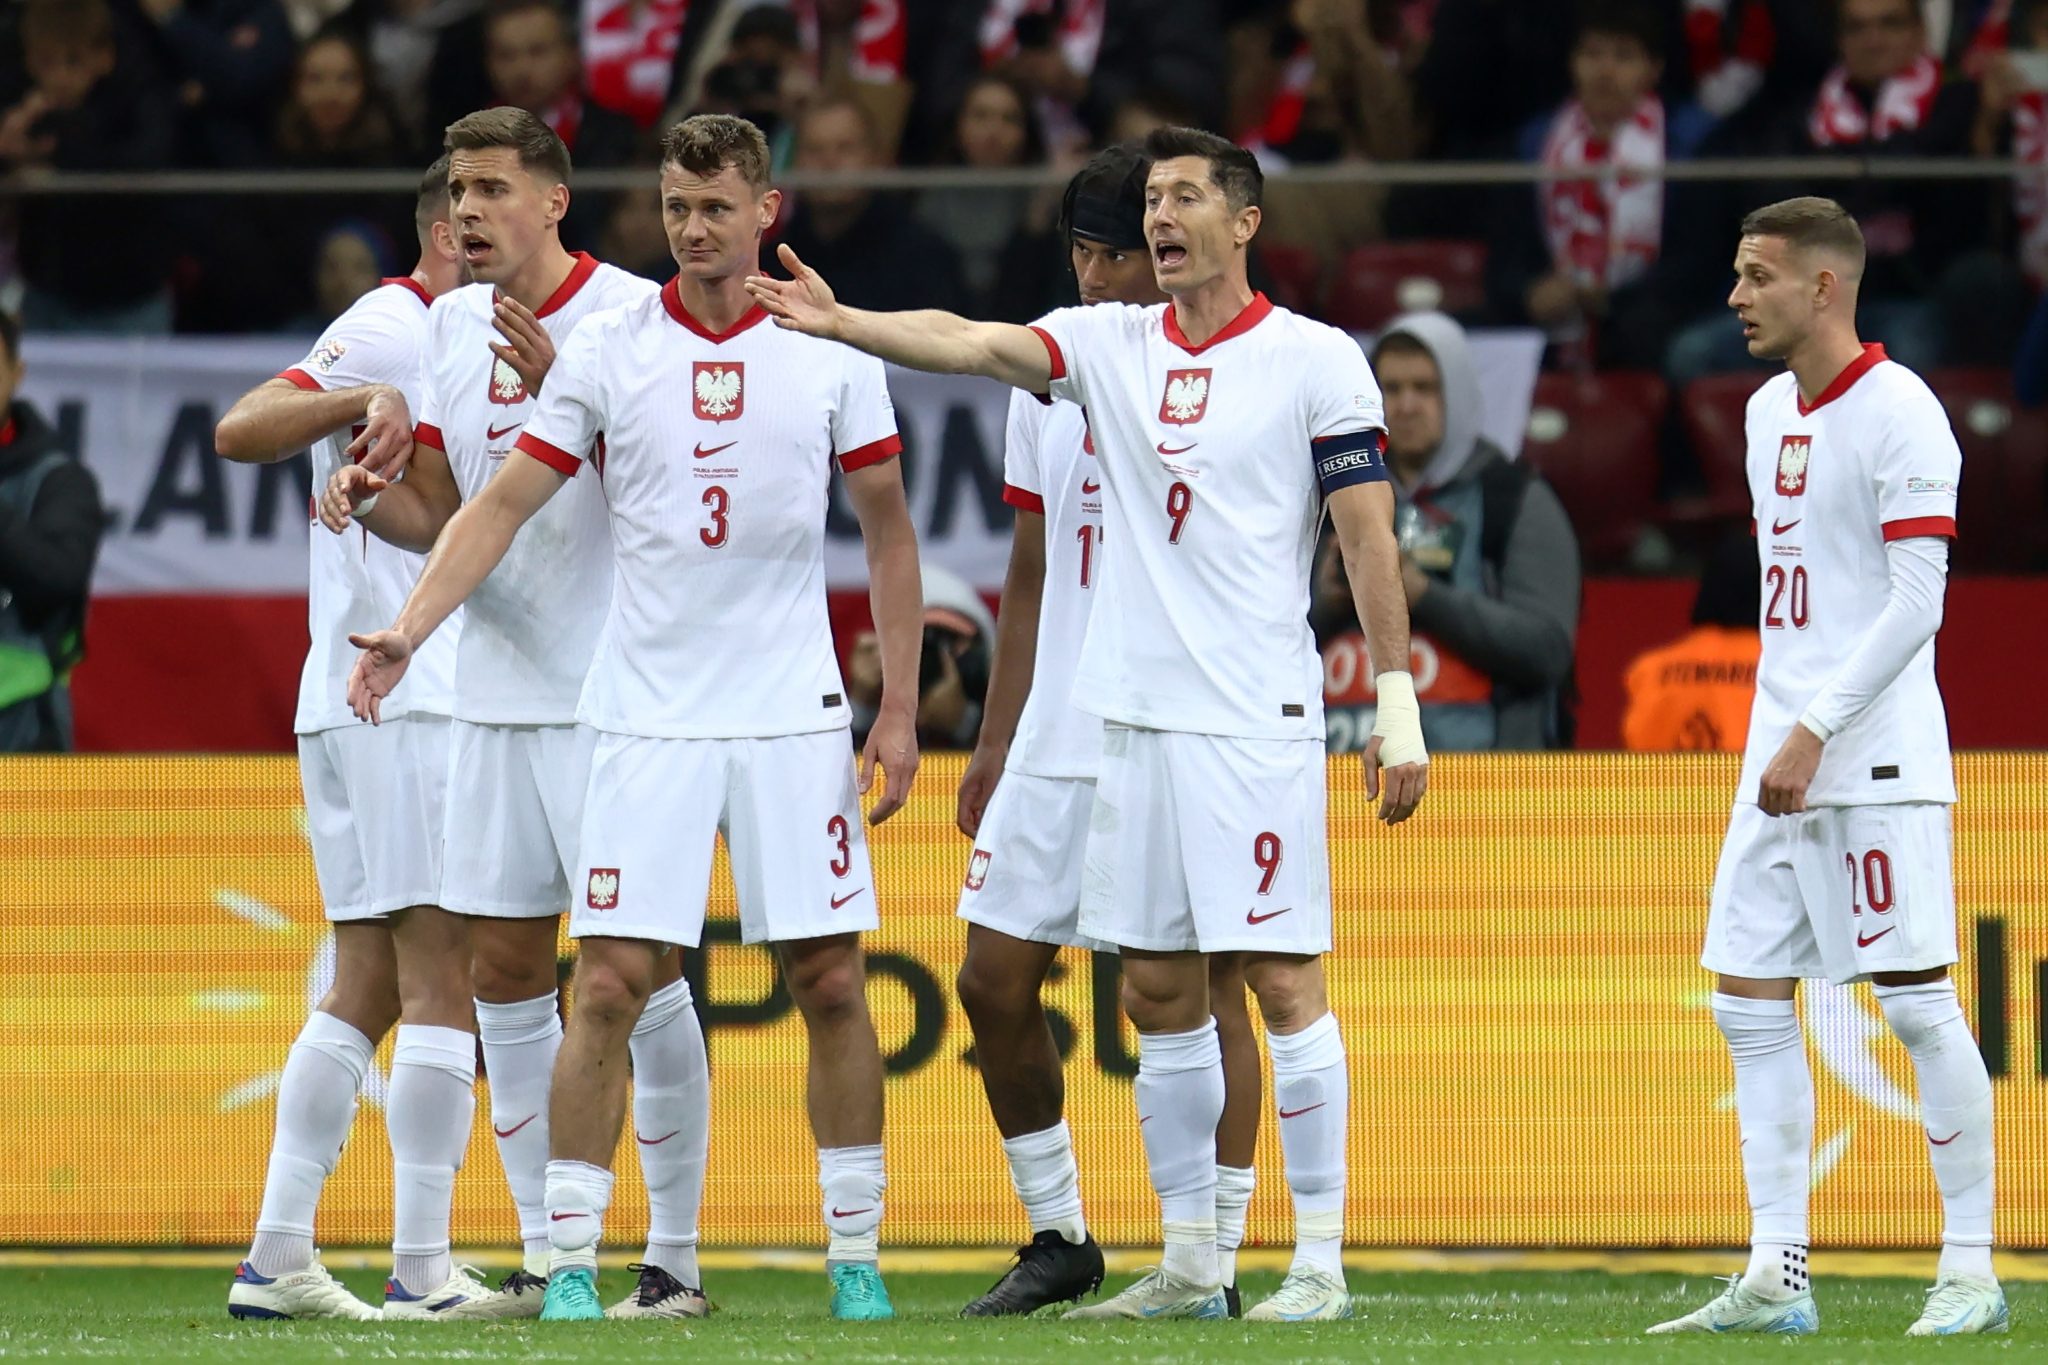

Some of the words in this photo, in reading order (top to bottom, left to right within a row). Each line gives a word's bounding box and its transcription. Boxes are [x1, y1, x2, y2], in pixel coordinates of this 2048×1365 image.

[1323, 452, 1370, 474] RESPECT
[700, 486, 730, 549] 3
[1167, 481, 1193, 545] 9
[1077, 524, 1103, 588] 1
[1765, 564, 1810, 630] 20
[827, 814, 852, 879] 3
[1254, 831, 1283, 895] 9
